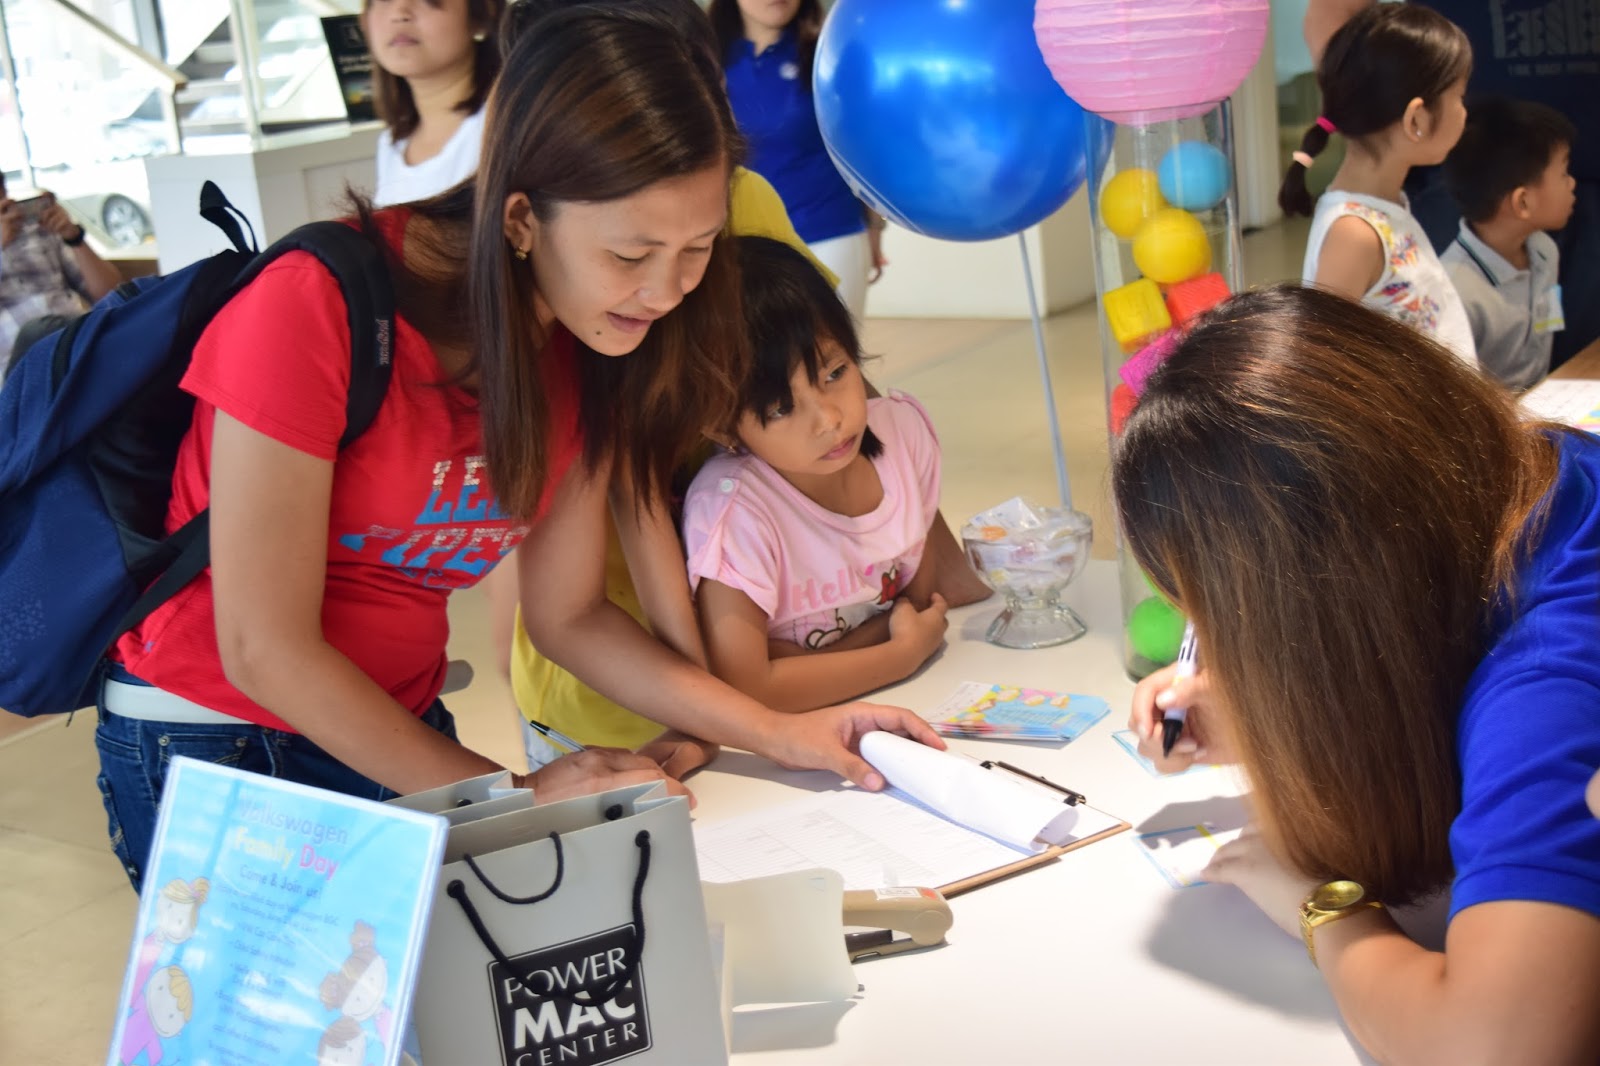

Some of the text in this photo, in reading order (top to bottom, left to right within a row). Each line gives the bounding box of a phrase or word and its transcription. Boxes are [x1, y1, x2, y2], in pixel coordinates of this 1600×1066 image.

[414, 455, 512, 525] LE
[238, 796, 348, 846] Volkswagen
[280, 876, 303, 895] Join
[299, 843, 339, 882] Day
[503, 946, 628, 1005] POWER
